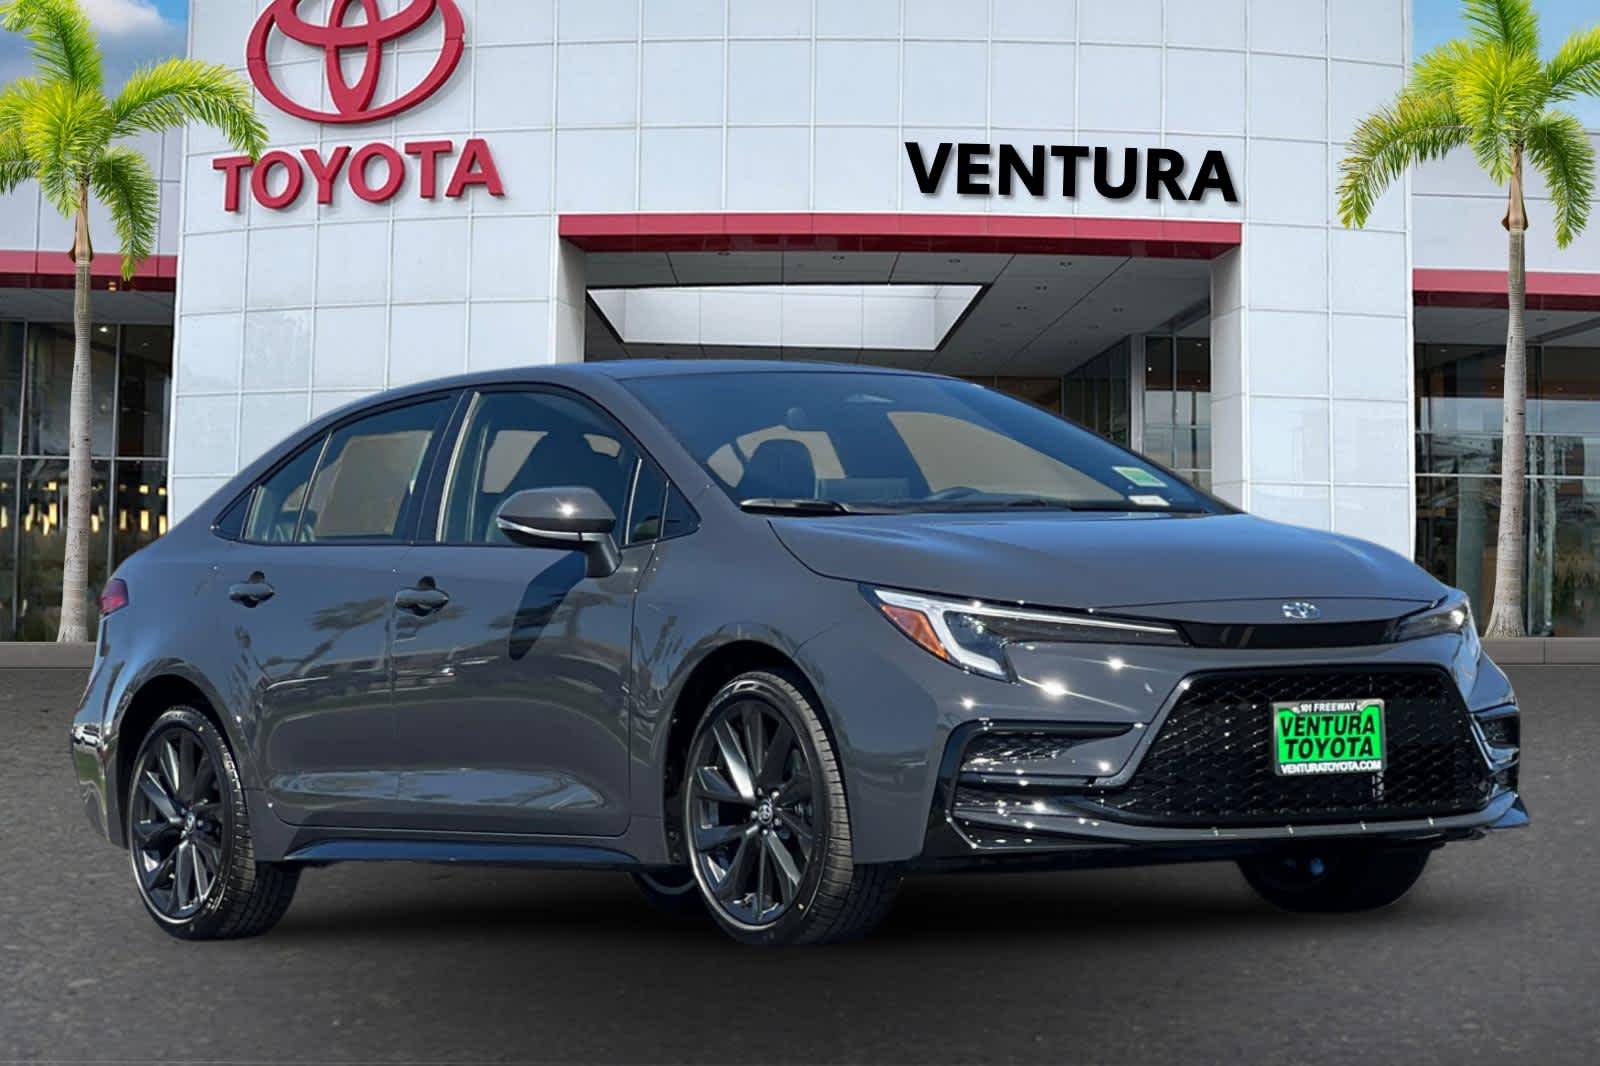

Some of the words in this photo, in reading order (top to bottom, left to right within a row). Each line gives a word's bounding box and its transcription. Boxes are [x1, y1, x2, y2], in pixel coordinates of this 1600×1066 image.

[213, 138, 505, 212] TOYOTA
[904, 141, 1239, 202] VENTURA
[1314, 703, 1356, 712] FREEWAY
[1280, 715, 1375, 737] VENTURA
[1284, 737, 1373, 759] TOYOTA
[1281, 760, 1382, 774] VENTURATOYOTA.COM
